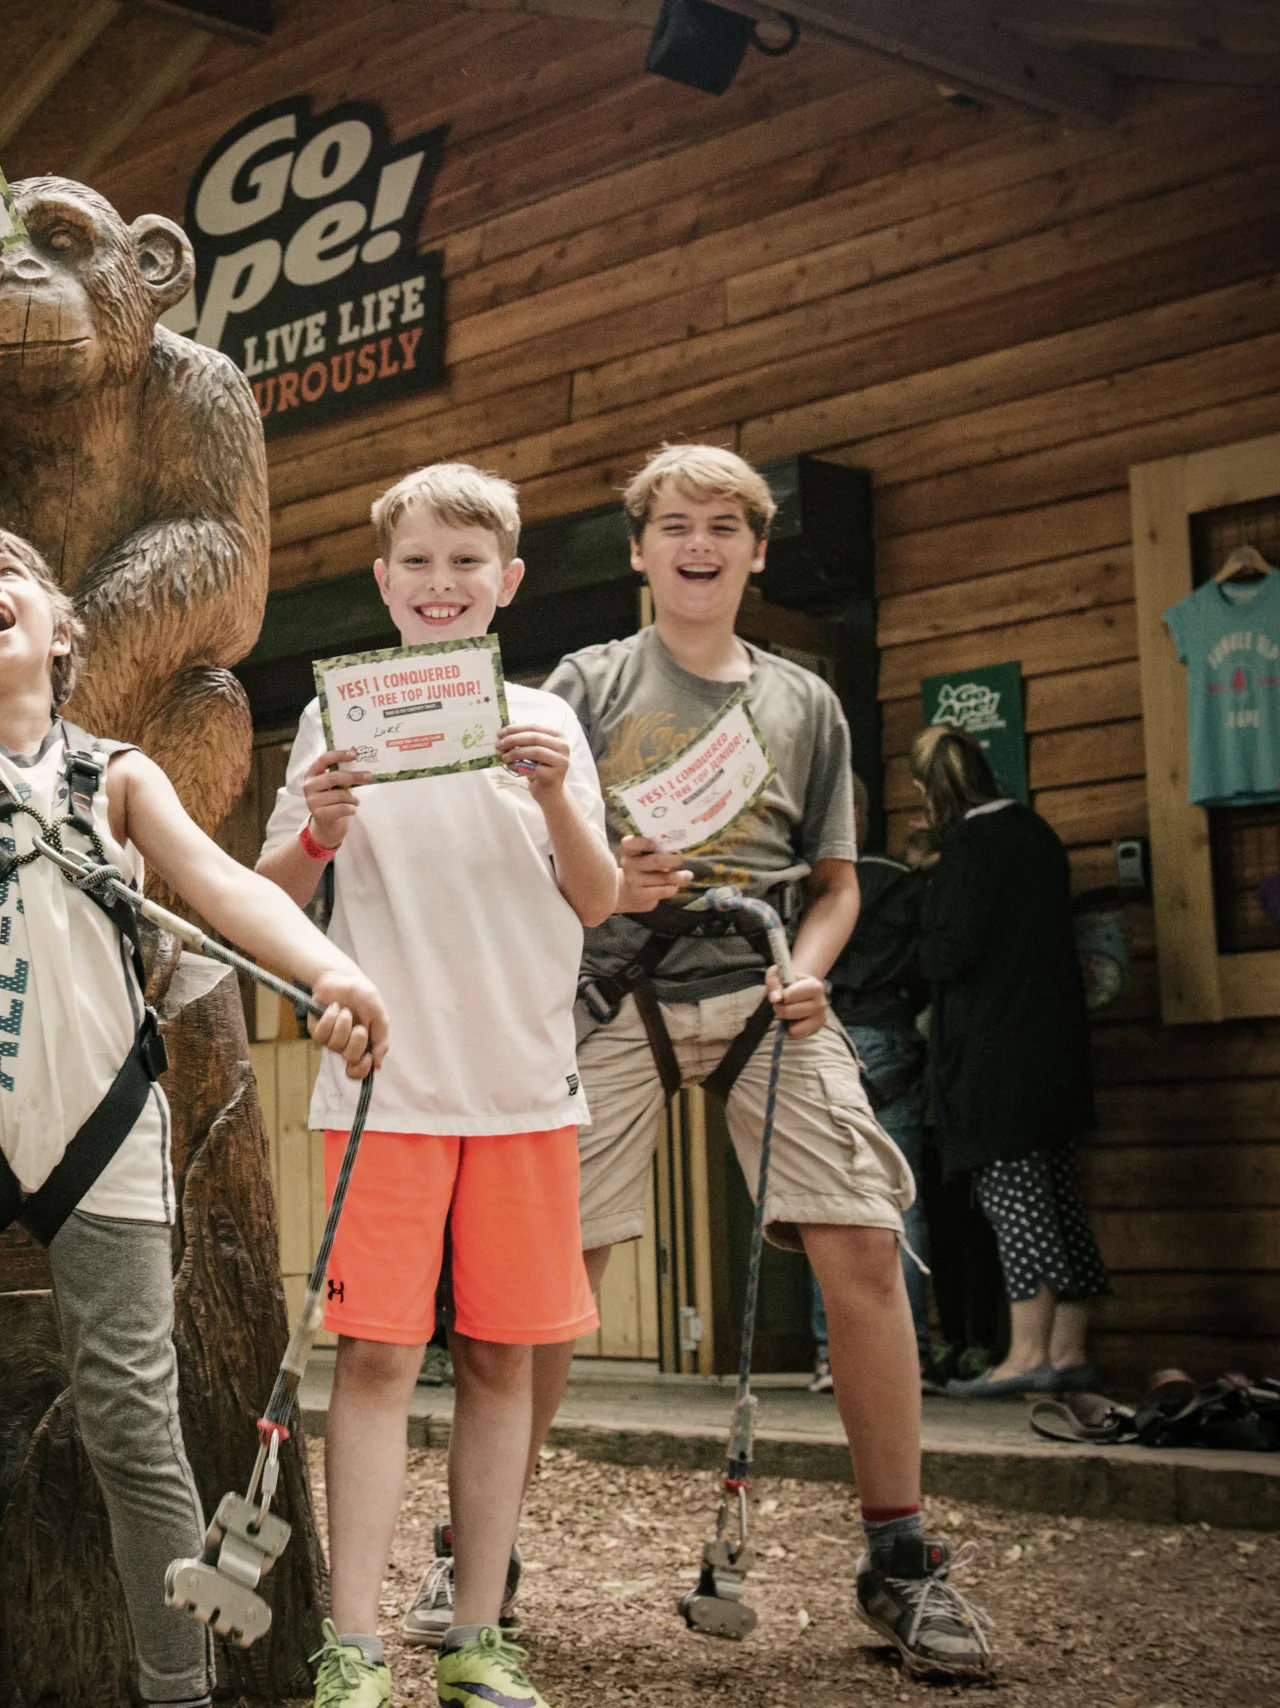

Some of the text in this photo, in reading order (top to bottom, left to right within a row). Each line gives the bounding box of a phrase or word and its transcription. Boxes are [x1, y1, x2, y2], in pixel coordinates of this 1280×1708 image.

[195, 113, 373, 236] Go
[160, 150, 426, 350] pe!
[243, 275, 426, 379] LIVE LIFE
[337, 664, 461, 701] YES! I CONQUERED
[370, 680, 481, 708] TREE TOP JUNIOR!
[637, 785, 668, 807] YES!
[667, 780, 676, 790] I
[675, 732, 728, 784] CONQUERED
[709, 731, 743, 772] JUNIOR!
